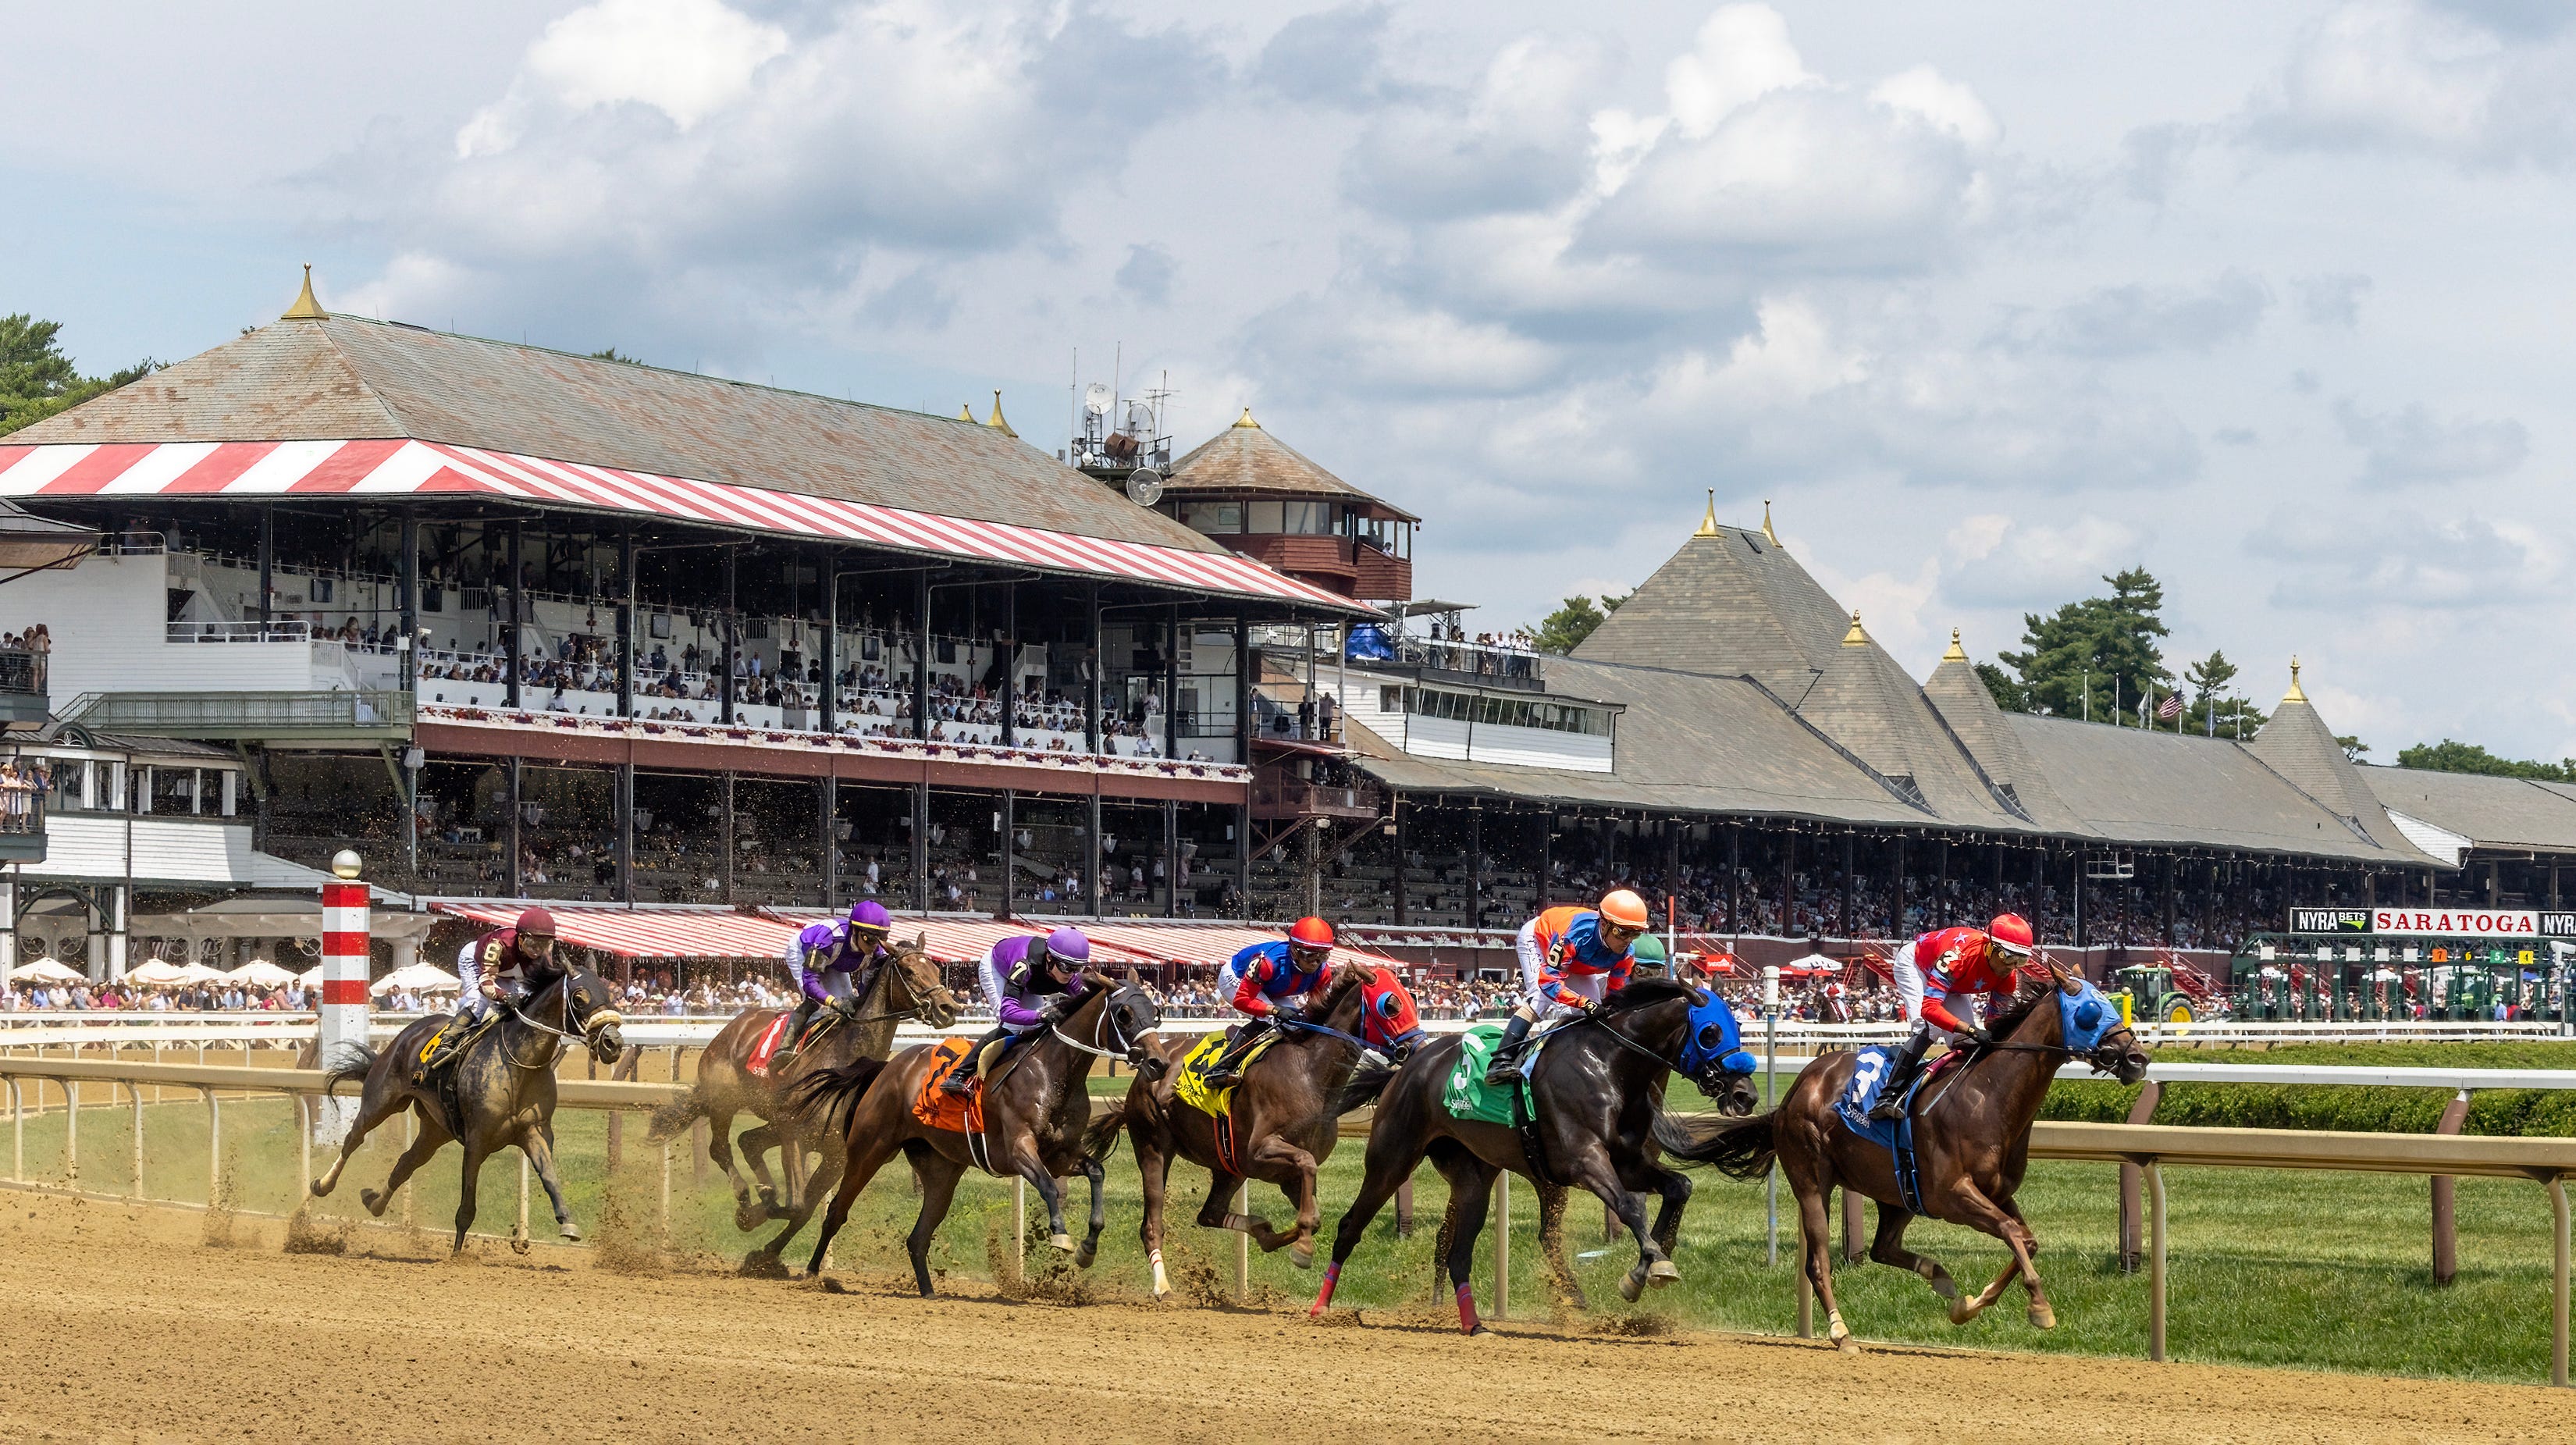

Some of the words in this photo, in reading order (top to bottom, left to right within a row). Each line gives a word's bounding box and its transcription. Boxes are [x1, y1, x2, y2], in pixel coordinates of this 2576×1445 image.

[2299, 911, 2338, 931] NYRA
[2338, 912, 2366, 921] BETS
[2377, 913, 2534, 932] SARATOGA
[2545, 914, 2576, 934] NYR
[483, 942, 503, 962] 6
[1546, 942, 1563, 968] 5
[1935, 949, 1959, 973] 3
[2437, 952, 2443, 960] 7
[2465, 952, 2472, 961] 6
[2494, 952, 2500, 961] 5
[2523, 953, 2529, 963] 4
[1010, 961, 1027, 981] 7
[1247, 957, 1261, 978] 4
[760, 1014, 788, 1059] 1
[925, 1045, 962, 1097] 7
[1851, 1051, 1886, 1103] 3
